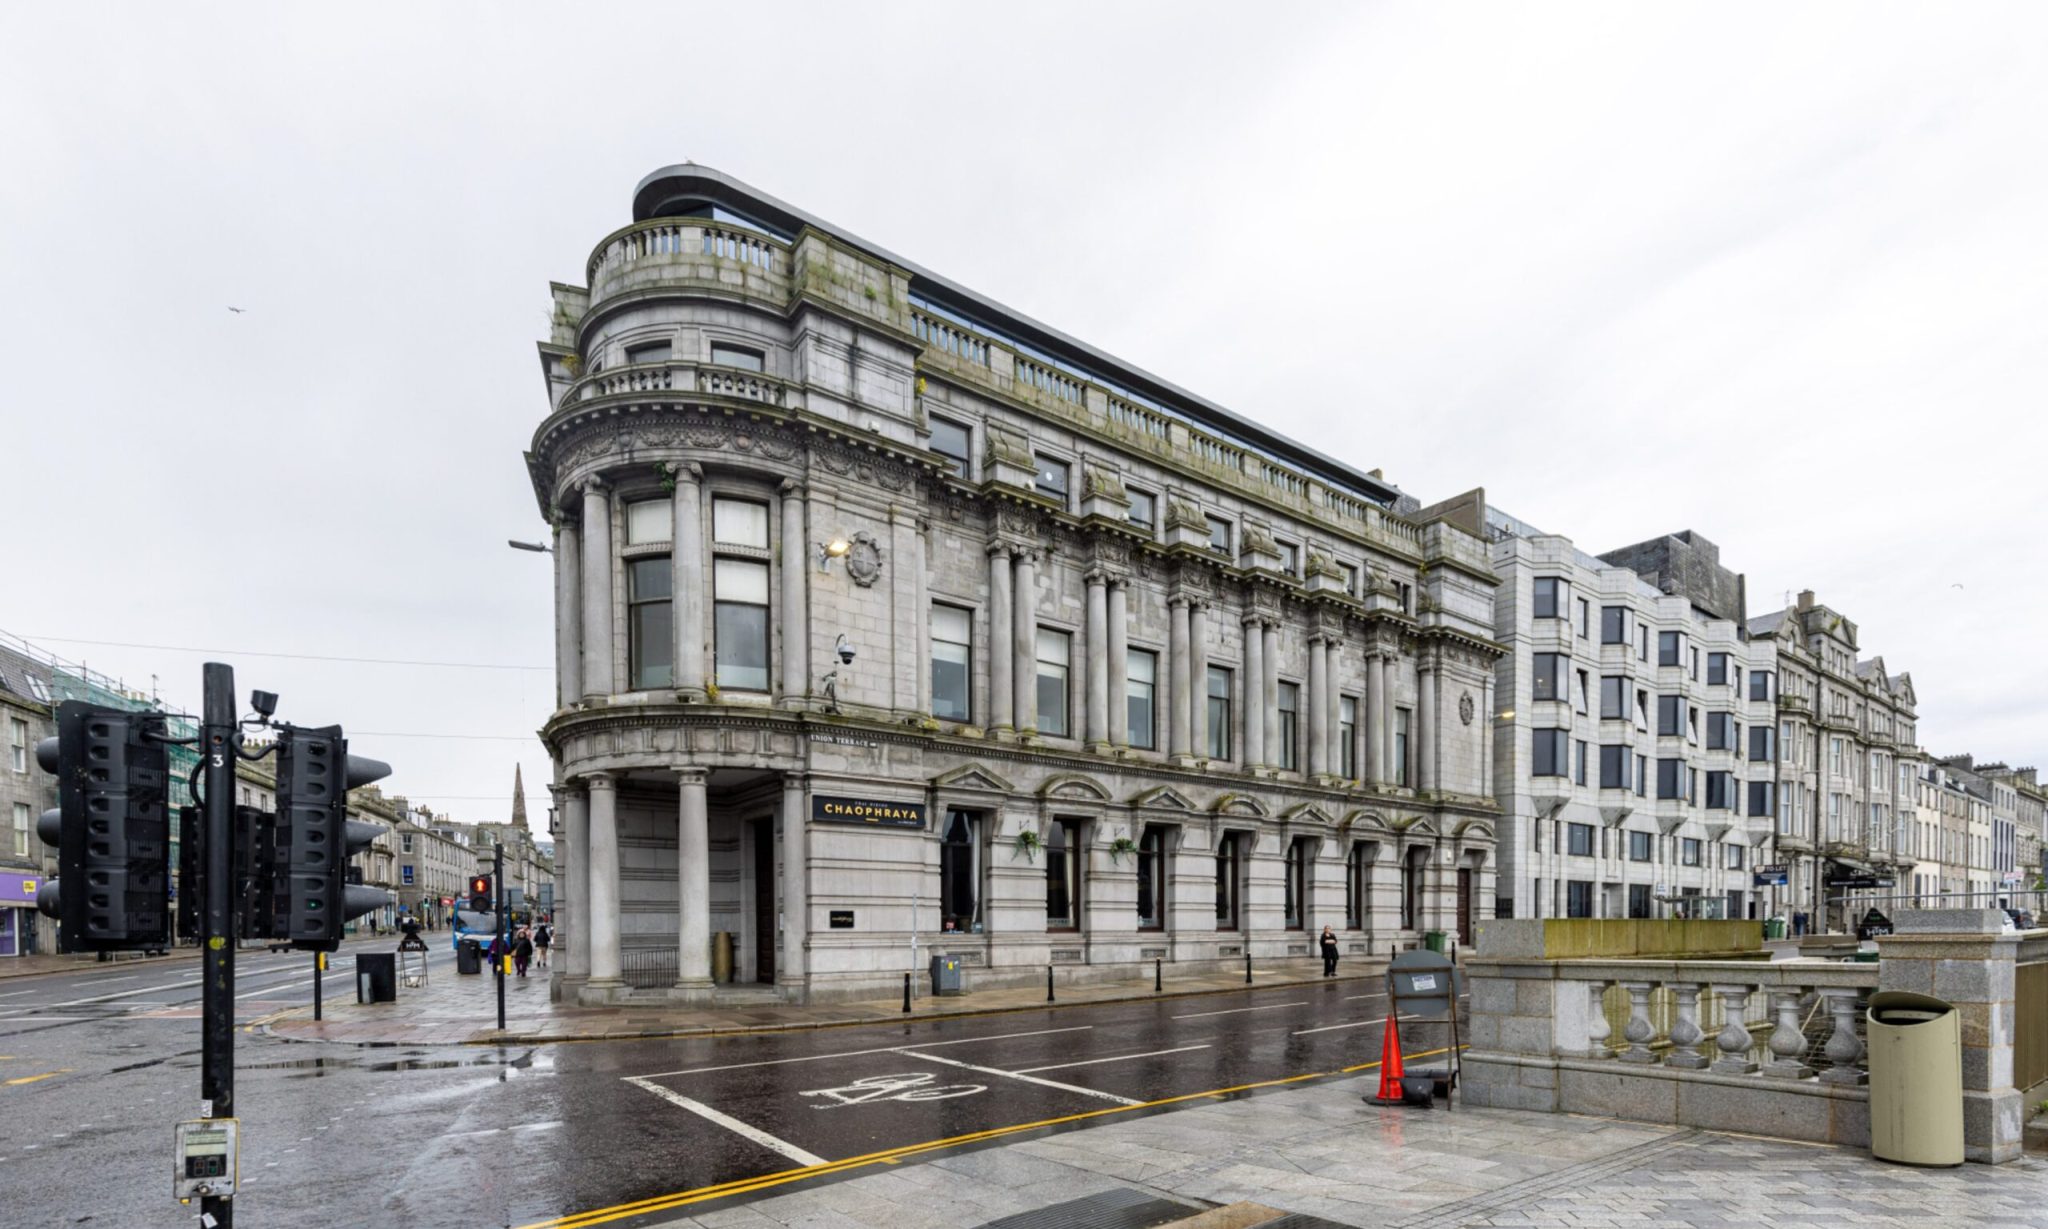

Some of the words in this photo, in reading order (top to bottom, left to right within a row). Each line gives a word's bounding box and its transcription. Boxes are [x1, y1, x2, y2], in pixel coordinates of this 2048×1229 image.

[811, 734, 833, 742] UNION
[836, 737, 868, 747] TERRACE
[212, 754, 224, 767] 3
[824, 803, 918, 820] CHAOPHRAYA
